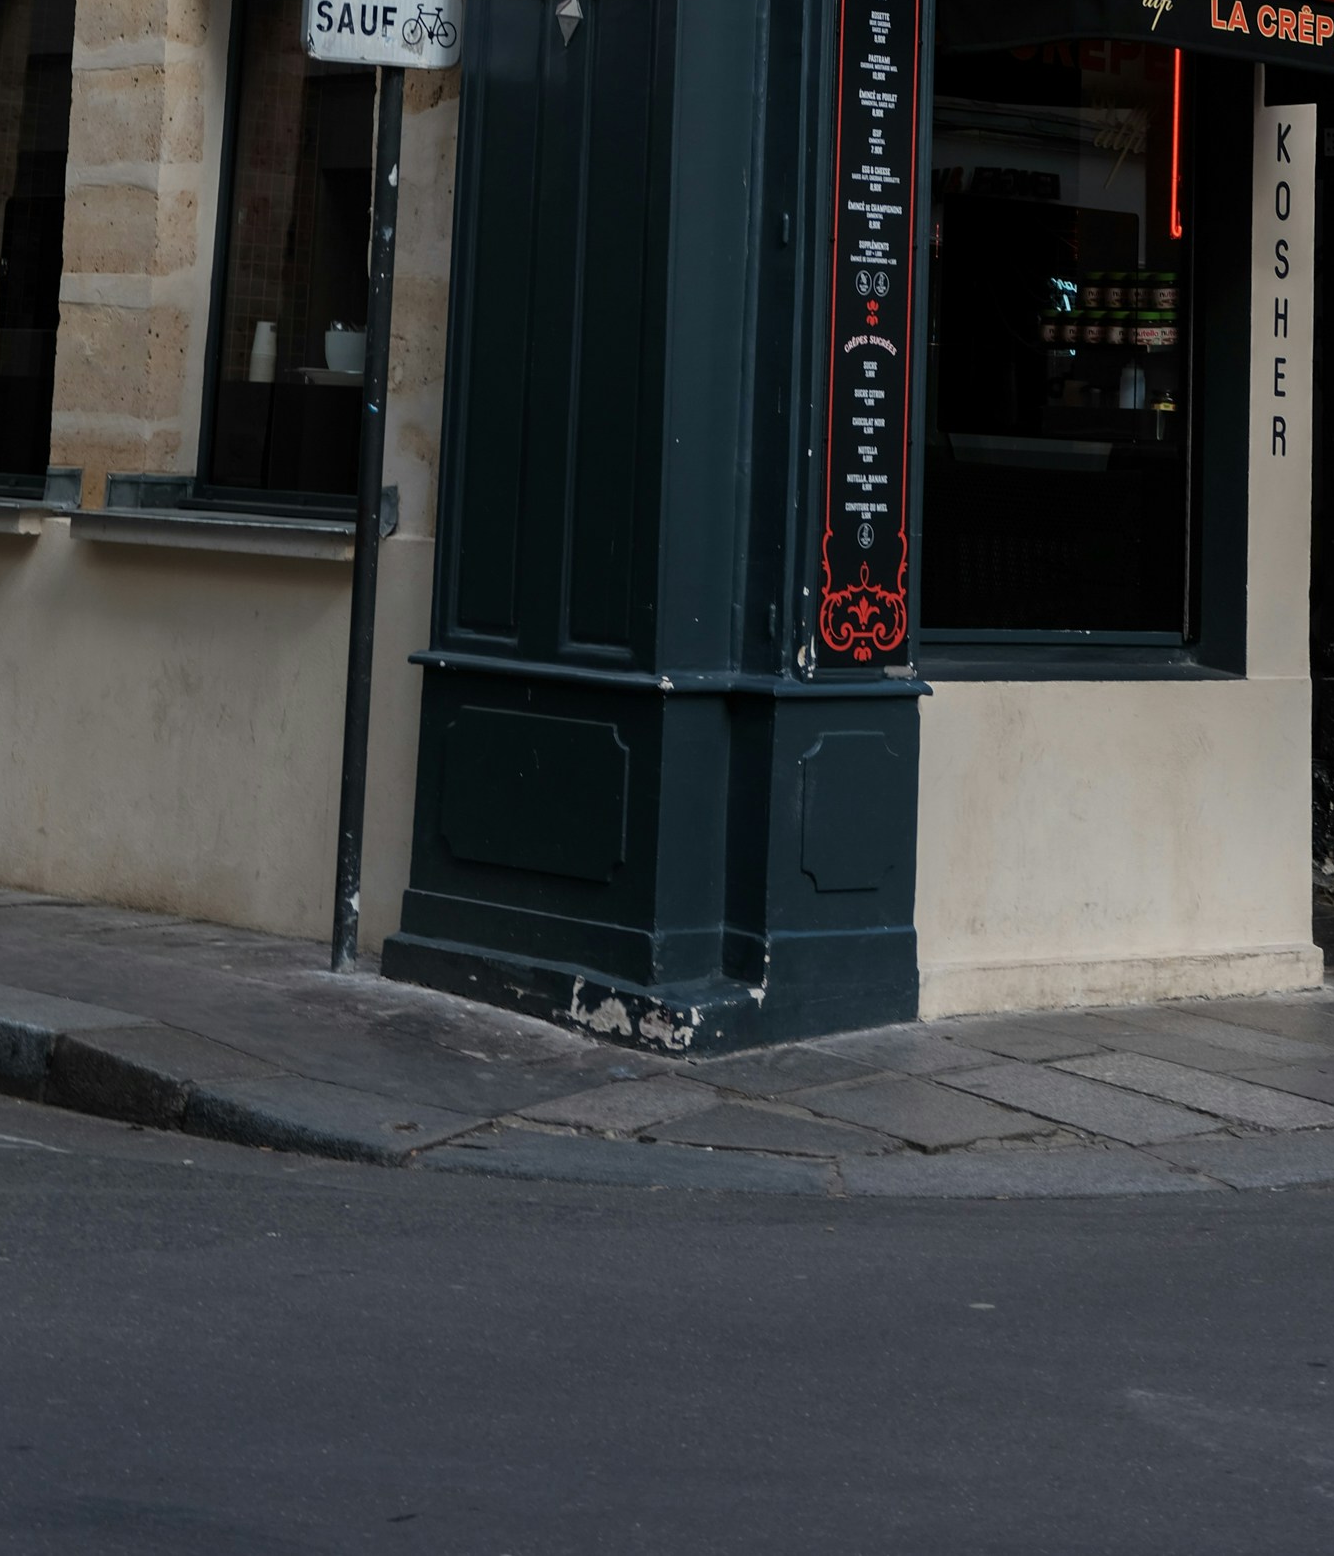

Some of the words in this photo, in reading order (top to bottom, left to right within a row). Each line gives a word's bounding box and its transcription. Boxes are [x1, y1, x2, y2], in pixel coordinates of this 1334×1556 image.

[315, 0, 398, 38] SAUF
[871, 10, 890, 21] ROSETTE
[868, 53, 890, 65] PASTRAMI
[859, 88, 876, 99] ÉMINCÉ
[882, 92, 897, 102] POULET
[875, 166, 891, 176] CHEESE
[848, 199, 865, 211] ÉMINCÉ
[871, 203, 902, 215] CHAMPIGNONS
[859, 239, 889, 251] SUPPLÉMENTS
[1272, 122, 1292, 457] KOSHER
[844, 335, 868, 353] CRÊPES
[869, 335, 897, 356] SUCRÉES
[863, 361, 877, 370] SUCRE
[854, 389, 868, 398] SUCRE
[869, 389, 885, 399] CITRON
[852, 417, 873, 426] CHOCOLAT
[874, 417, 885, 427] NOIR
[858, 445, 878, 455] NUTELLA
[868, 474, 888, 484] BANANE
[845, 502, 869, 511] CONFITURE
[877, 503, 888, 512] MIEL
